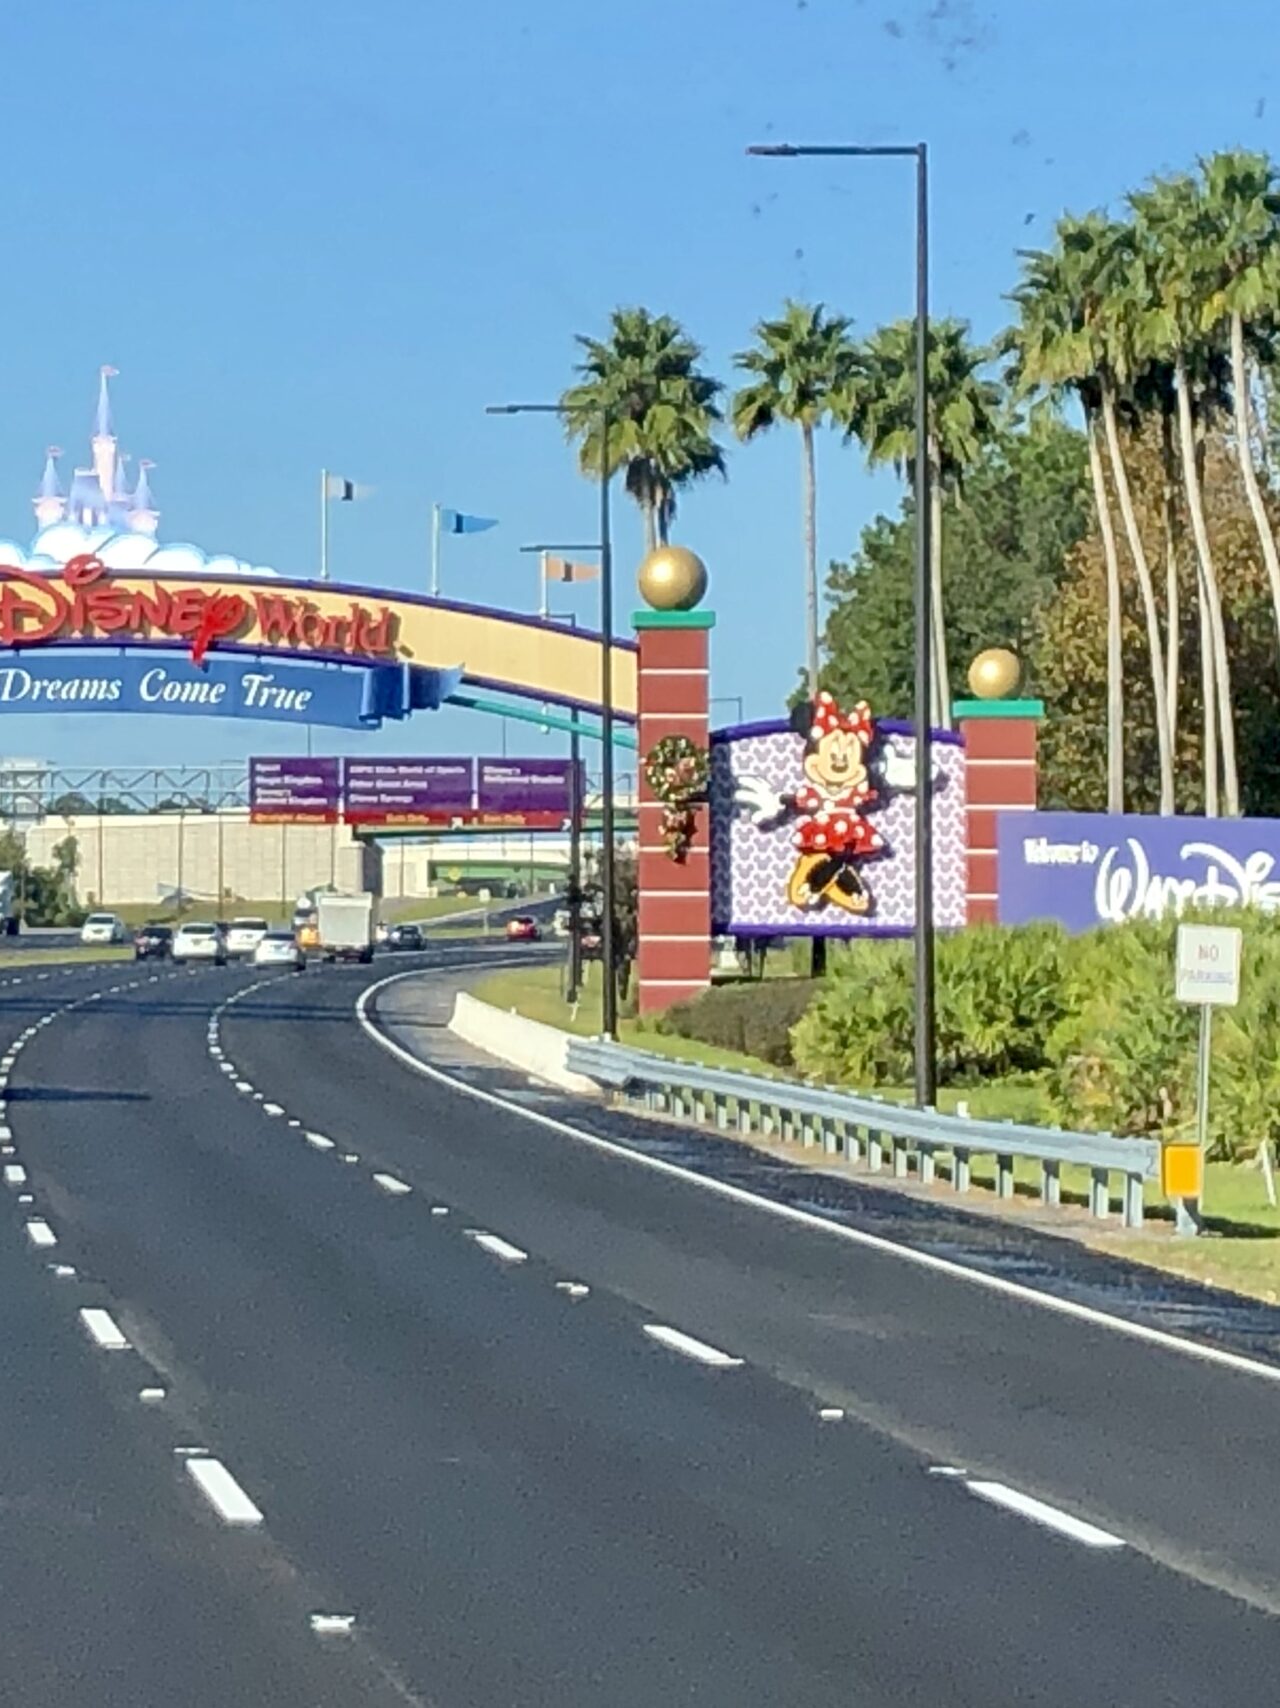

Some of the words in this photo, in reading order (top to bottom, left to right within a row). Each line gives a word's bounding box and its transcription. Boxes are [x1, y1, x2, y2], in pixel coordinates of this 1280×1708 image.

[253, 592, 392, 655] World
[139, 668, 226, 704] Come
[242, 673, 313, 711] True
[1198, 944, 1220, 962] NO
